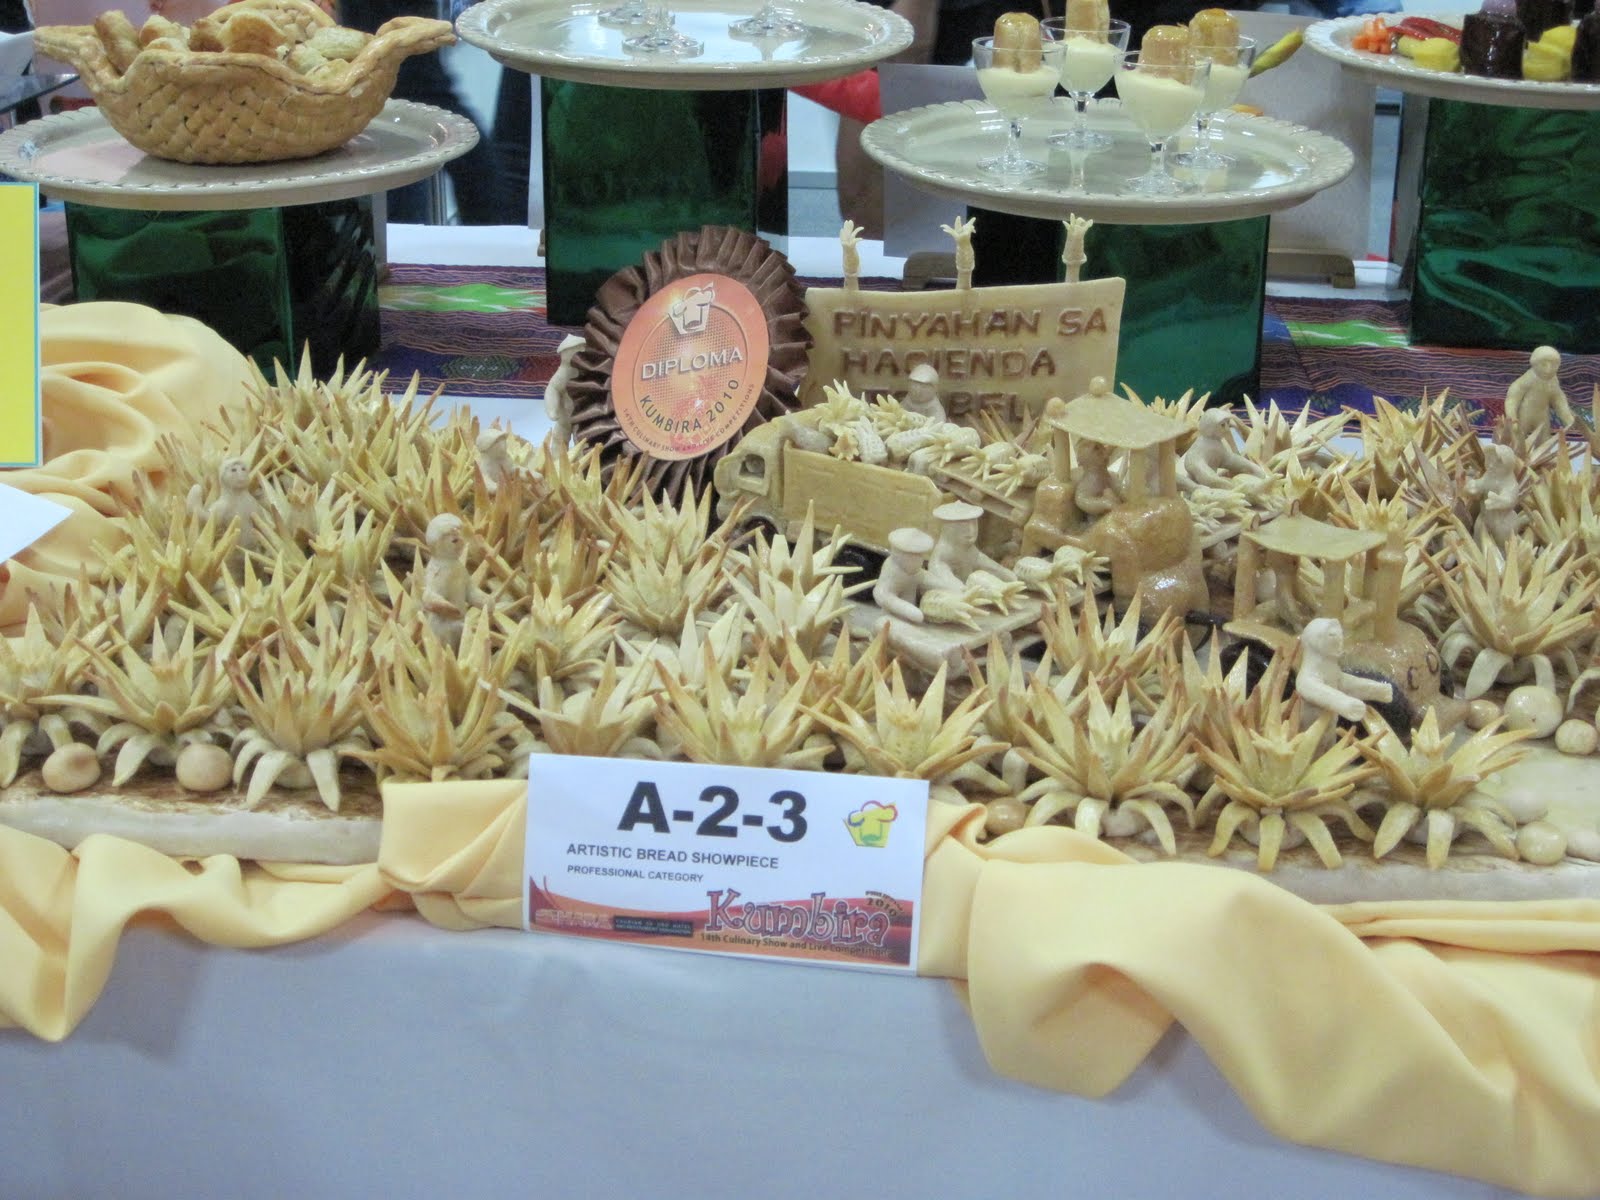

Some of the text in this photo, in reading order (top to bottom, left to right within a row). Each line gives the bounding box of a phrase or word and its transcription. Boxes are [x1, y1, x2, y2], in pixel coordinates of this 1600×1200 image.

[833, 308, 1108, 339] PINYAHAN SA
[642, 347, 743, 379] DIPLOMA
[842, 349, 1056, 377] HACIENDA
[640, 380, 739, 433] KUMBIRA 2010
[617, 781, 809, 843] A-2-3
[566, 842, 780, 870] ARTISTIC BREAD SHOWPIECE
[567, 865, 704, 884] PROFESSIONAL CATEGORY
[705, 887, 891, 947] Kumbira
[723, 935, 761, 948] Culinary
[763, 938, 787, 949] Show
[789, 941, 807, 950] and
[809, 942, 828, 952] Live
